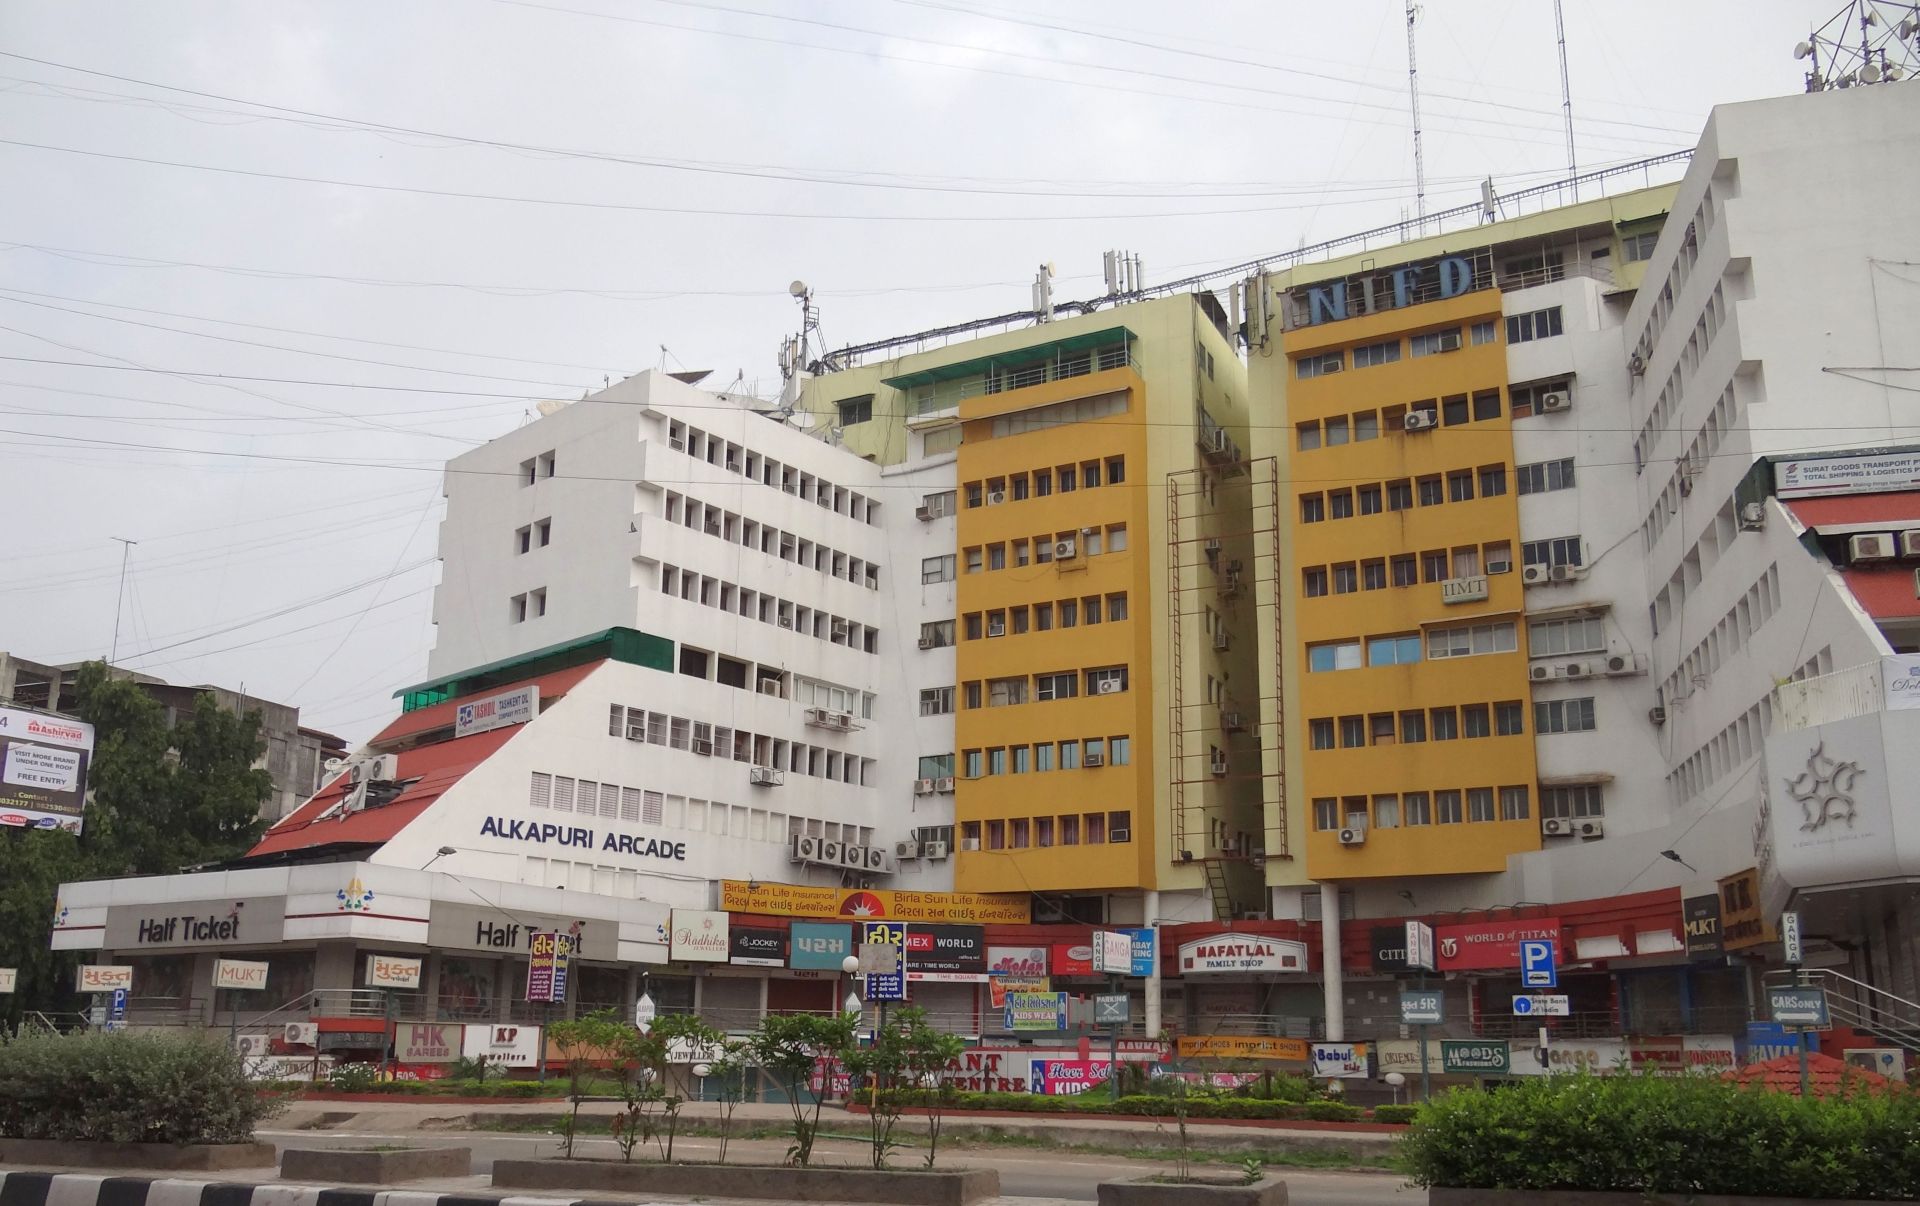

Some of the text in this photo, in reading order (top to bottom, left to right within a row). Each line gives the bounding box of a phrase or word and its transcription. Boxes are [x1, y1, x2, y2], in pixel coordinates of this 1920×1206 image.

[1803, 466, 1829, 474] SURAT
[1831, 463, 1860, 471] GOODS
[1863, 460, 1911, 469] TRANSPORT
[1829, 471, 1864, 479] SHIPPING
[499, 695, 522, 710] TASHKENT
[41, 726, 82, 739] Ashirvad
[15, 758, 38, 766] UNDER
[55, 763, 72, 771] ROOF
[17, 773, 67, 785] FREE ENTRY
[480, 816, 686, 860] ALKAPURI ARCADE
[724, 883, 834, 900] Birla Sun Life Insurance
[894, 893, 1026, 906] Birla Sun Life Insurance
[138, 915, 239, 942] Half Ticket
[477, 921, 519, 947] Half
[1684, 918, 1716, 936] MUKT
[675, 928, 727, 947] Radhika
[937, 938, 973, 947] WORLD
[1464, 929, 1558, 943] WORLD of TITAN
[1787, 916, 1797, 960] GANGA
[1197, 944, 1275, 957] MAFATLAL
[1525, 943, 1548, 970] P
[1206, 960, 1264, 968] FAMILY SHOP
[221, 967, 266, 981] MUKT
[115, 990, 125, 1006] P
[1096, 995, 1127, 1003] PARKING
[1771, 996, 1821, 1009] CARS ONLY
[1034, 1011, 1056, 1019] WEAR
[411, 1024, 446, 1046] HK
[496, 1028, 518, 1042] KP
[406, 1047, 449, 1057] SAREES
[1318, 1049, 1351, 1061] Babul
[1447, 1047, 1505, 1067] MOODS
[1048, 1063, 1083, 1079] Heer
[1055, 1082, 1091, 1095] KIDS
